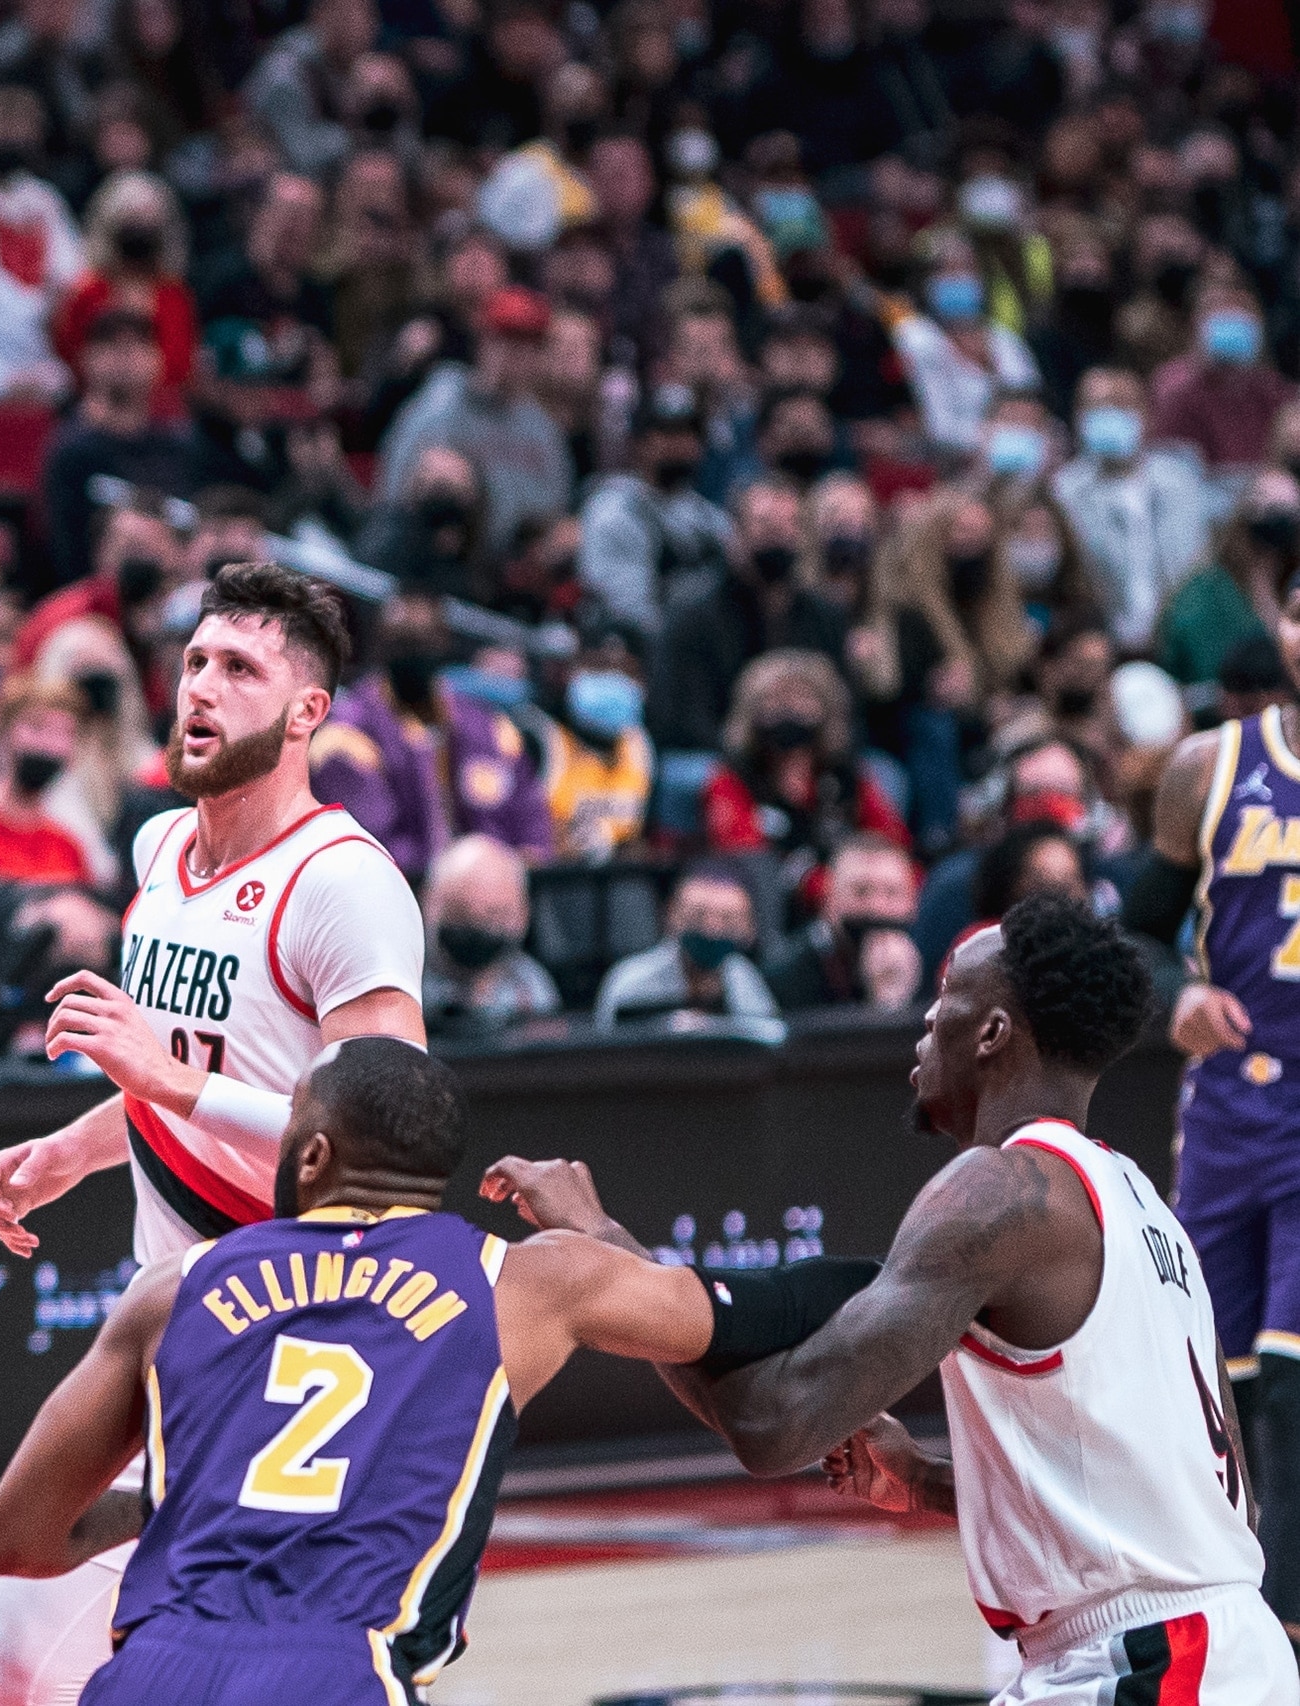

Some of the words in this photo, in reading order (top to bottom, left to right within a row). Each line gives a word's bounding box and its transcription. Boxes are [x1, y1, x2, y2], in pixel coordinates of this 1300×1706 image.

[222, 910, 259, 928] StormX
[202, 1251, 469, 1342] ELLINGTON
[238, 1334, 374, 1513] 2
